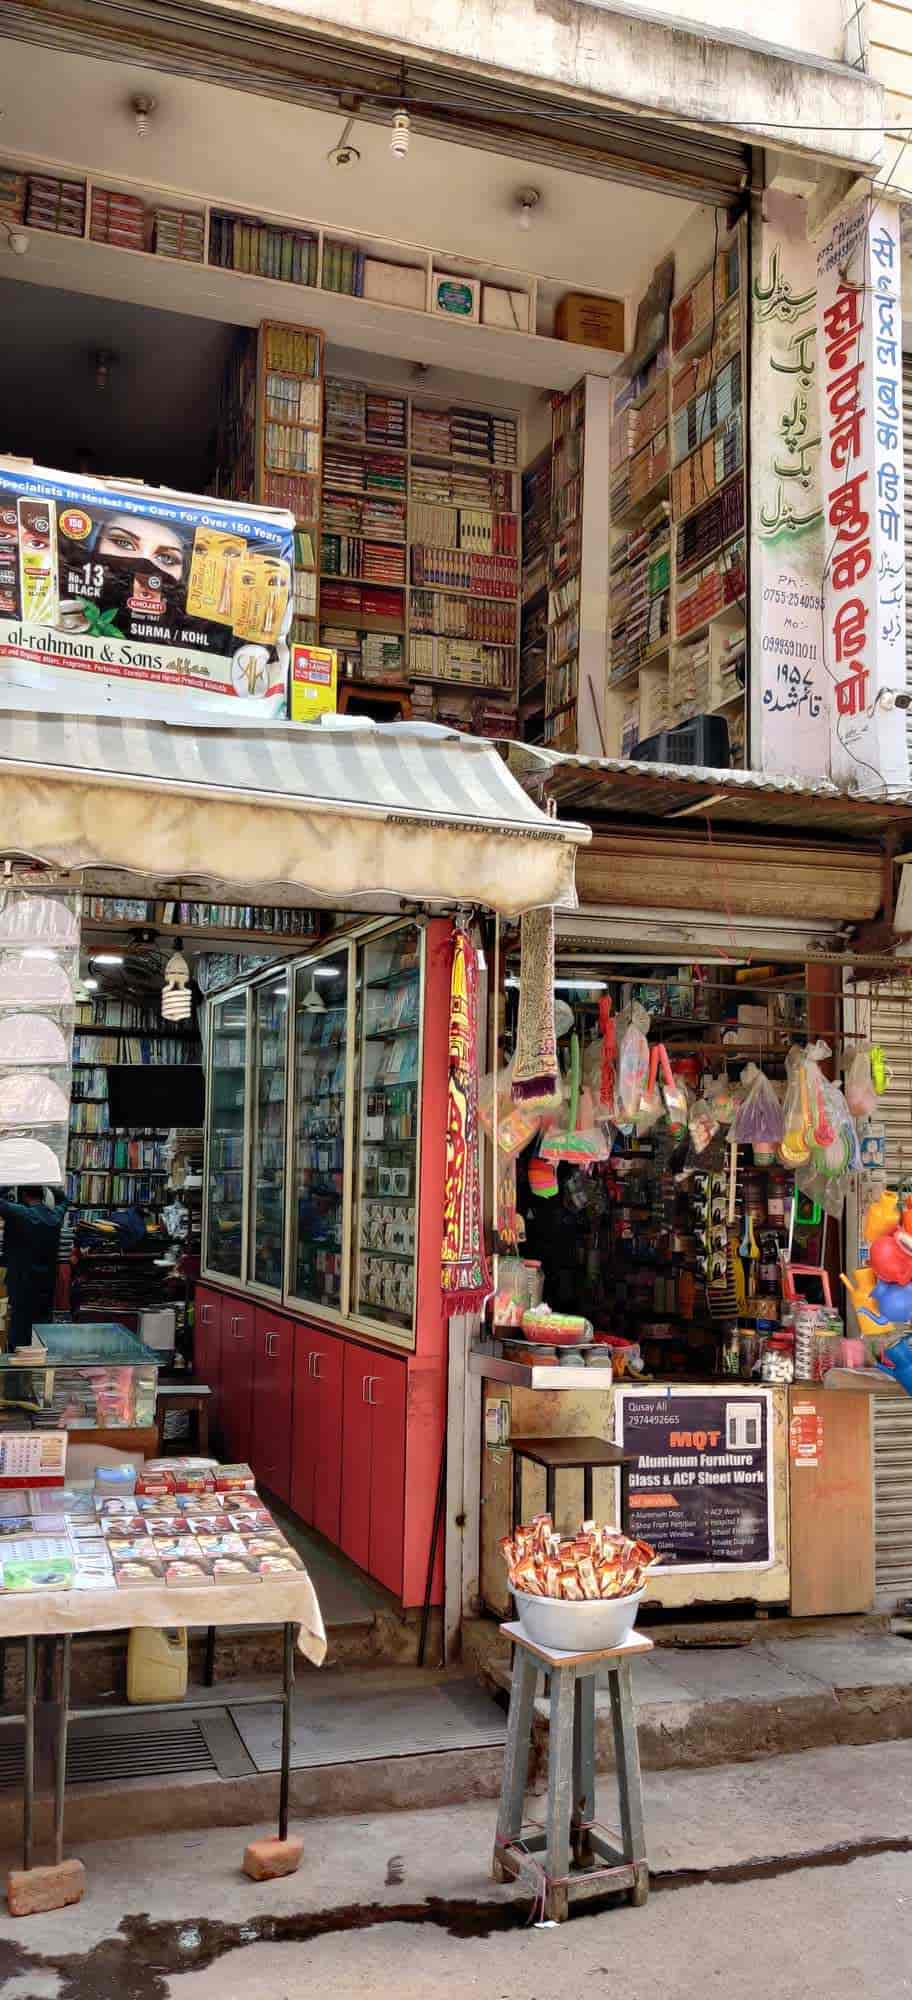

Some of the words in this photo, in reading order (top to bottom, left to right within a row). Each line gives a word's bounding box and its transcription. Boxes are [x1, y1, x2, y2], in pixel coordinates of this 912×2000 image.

[67, 489, 78, 499] In
[125, 502, 145, 513] Eye
[150, 505, 177, 519] Care
[180, 511, 198, 522] For
[201, 515, 227, 529] Over
[231, 523, 251, 534] 150
[254, 526, 282, 543] Years
[67, 583, 102, 599] BLACK
[130, 623, 171, 640] SURMA
[181, 631, 210, 646] KOHL
[8, 627, 94, 659] al-rahman
[101, 644, 114, 663] &
[628, 1402, 654, 1413] Qusay
[656, 1401, 668, 1412] Ali
[669, 1430, 721, 1450] MQT
[638, 1454, 698, 1469] Aluminum
[700, 1453, 753, 1467] Furniture
[628, 1473, 660, 1488] Glass
[663, 1475, 672, 1486] &
[673, 1471, 697, 1486] ACP
[698, 1471, 732, 1485] Sheet
[733, 1470, 764, 1484] Work
